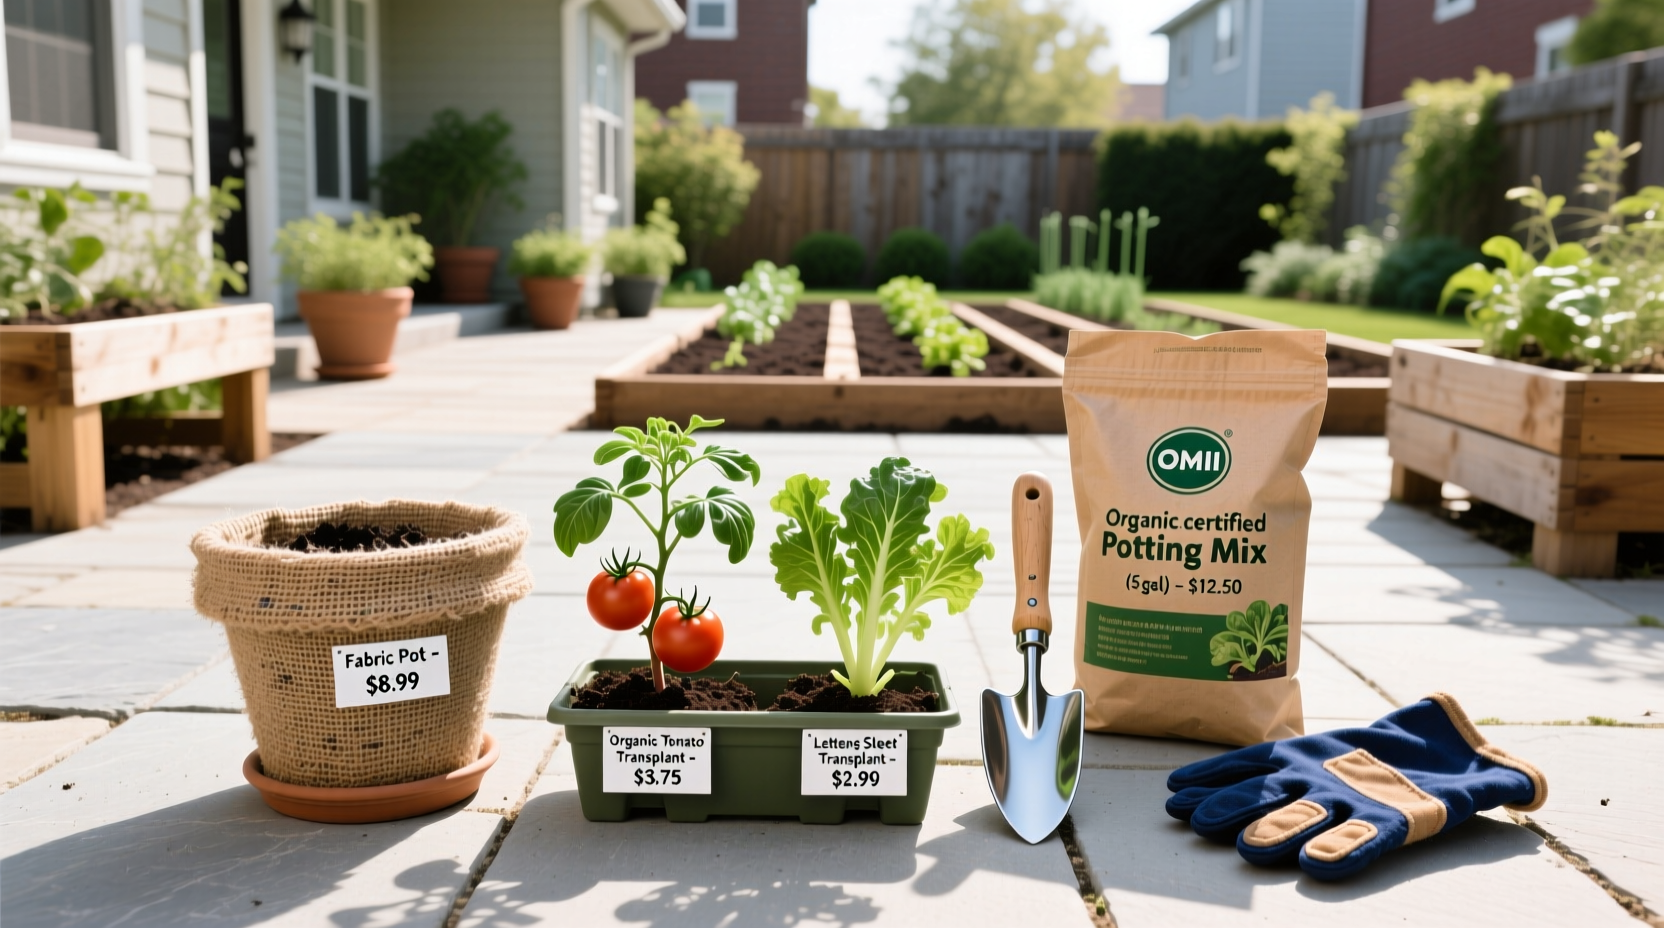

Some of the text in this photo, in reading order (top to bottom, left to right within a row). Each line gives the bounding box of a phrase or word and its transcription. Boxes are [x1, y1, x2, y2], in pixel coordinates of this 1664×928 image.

[1157, 448, 1220, 472] OMII
[1102, 531, 1267, 570] Potting Mix
[1188, 578, 1242, 595] $12.50
[345, 650, 394, 669] Fabric
[398, 646, 427, 664] Pot
[366, 671, 420, 697] $8.99
[609, 734, 658, 750] Organic
[616, 750, 685, 767] Transplant
[818, 751, 886, 769] Transplant
[634, 768, 682, 787] $3.75
[832, 769, 880, 790] $2.99
